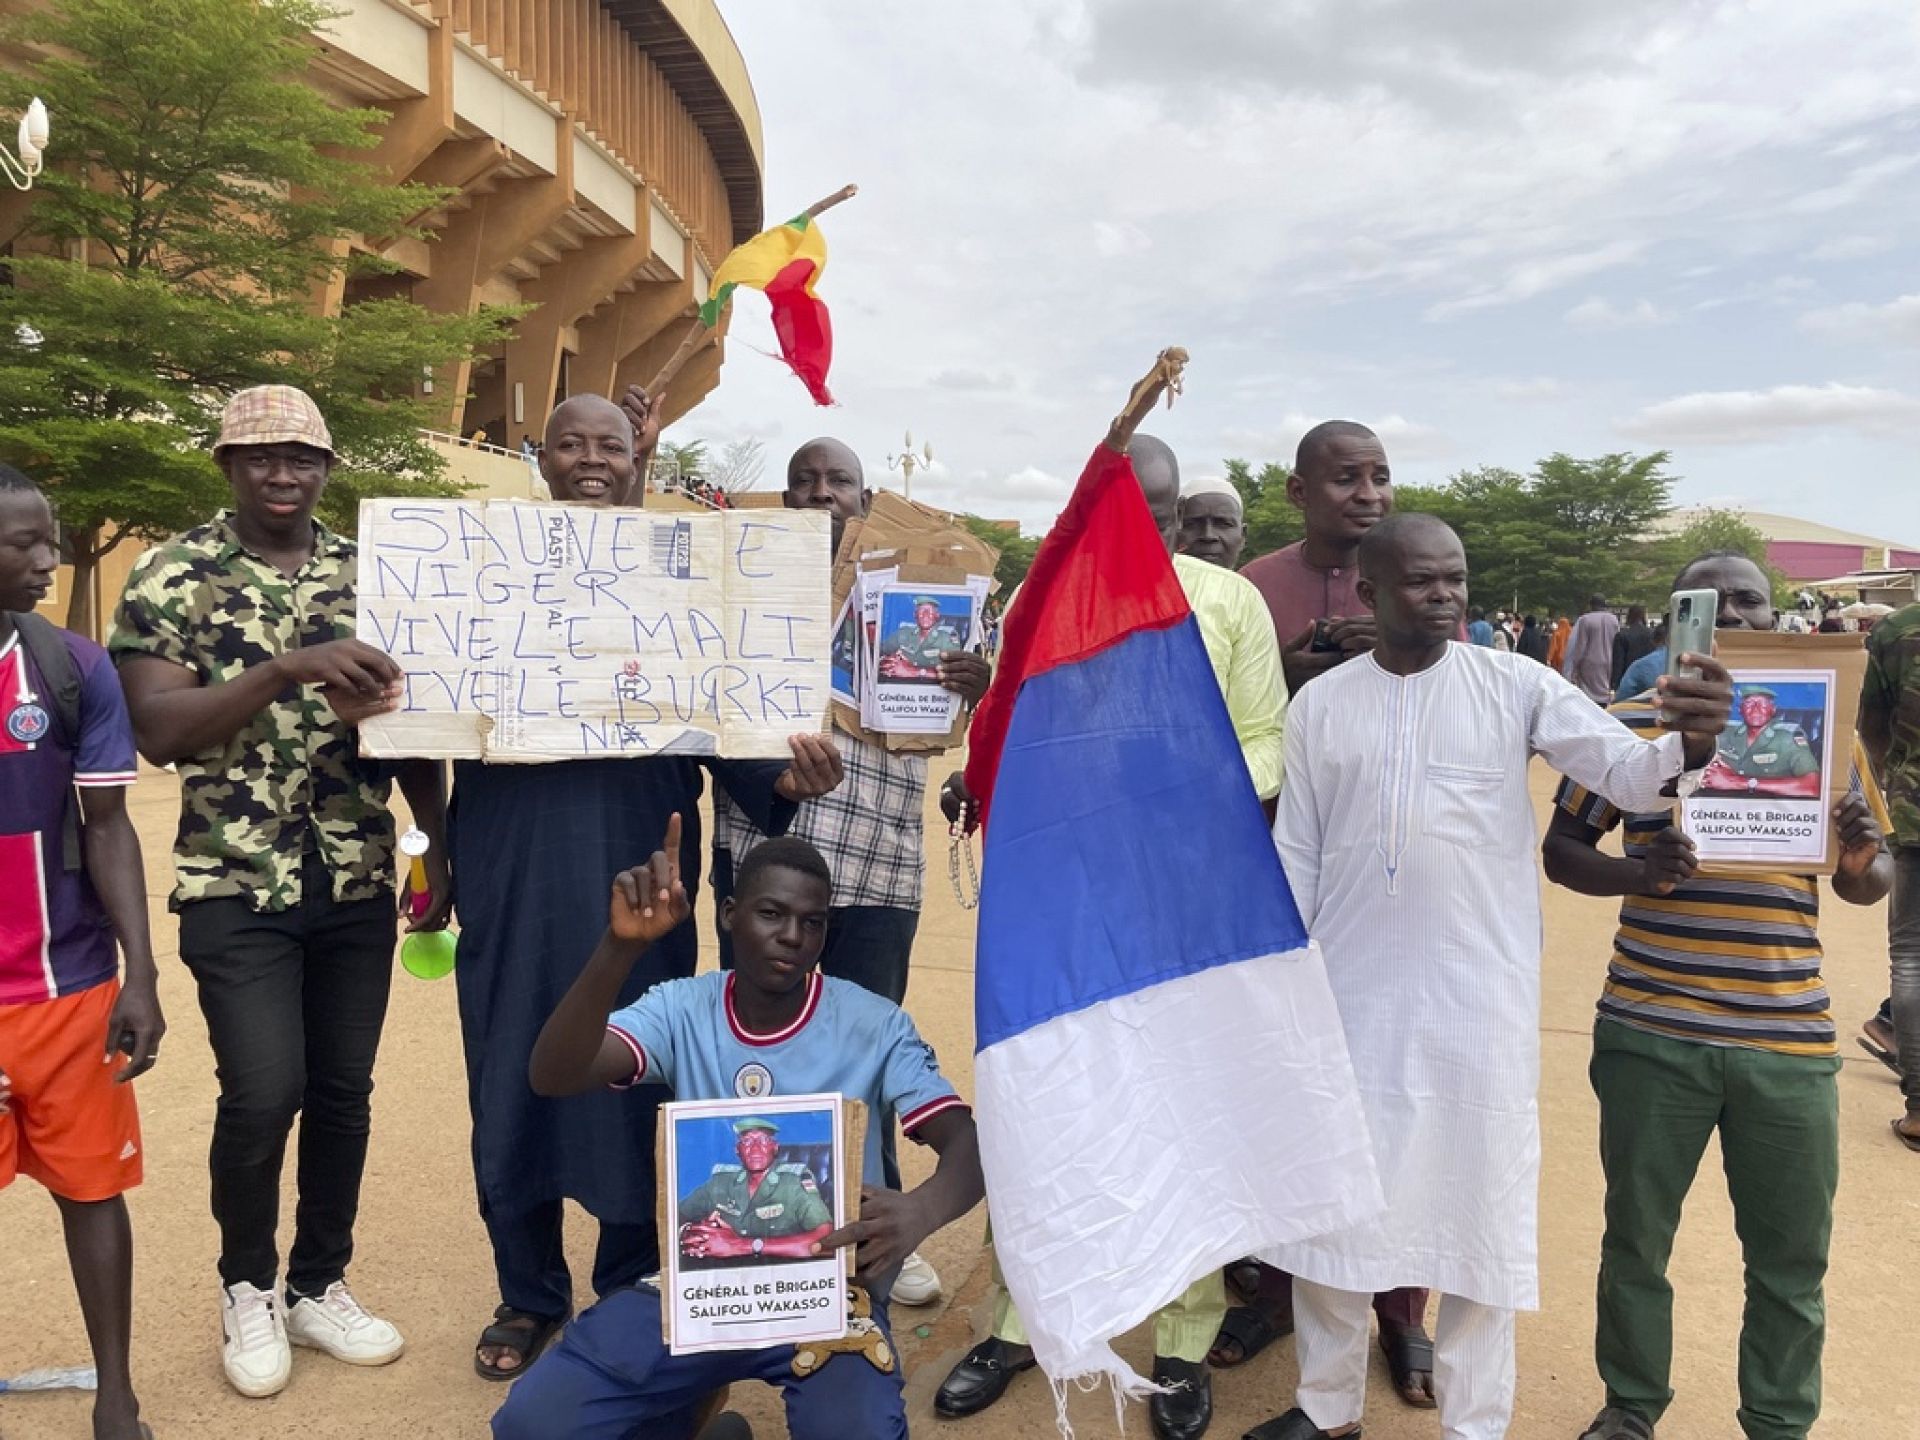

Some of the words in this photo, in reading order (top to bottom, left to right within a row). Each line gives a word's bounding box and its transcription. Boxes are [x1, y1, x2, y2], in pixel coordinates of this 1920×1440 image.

[375, 506, 639, 571] SAUVE
[376, 555, 630, 610] NIGER
[632, 608, 815, 662] MALI
[402, 668, 508, 713] IVE
[614, 665, 814, 725] BURKI
[918, 694, 929, 703] DE
[880, 704, 918, 713] SALIFOU
[581, 715, 650, 753] NA
[1690, 808, 1743, 821] GÉNÉRAL
[1746, 811, 1762, 821] DE
[1765, 811, 1819, 823] BRIGADE
[1694, 823, 1745, 835] SALIFOU
[1748, 824, 1812, 837] WAKASSO
[683, 1285, 749, 1300] GÉNÉRAL
[753, 1282, 772, 1295] DE
[775, 1277, 836, 1294] BRIGADE
[689, 1303, 753, 1319] SALIFOU
[757, 1297, 830, 1313] WAKASSO
